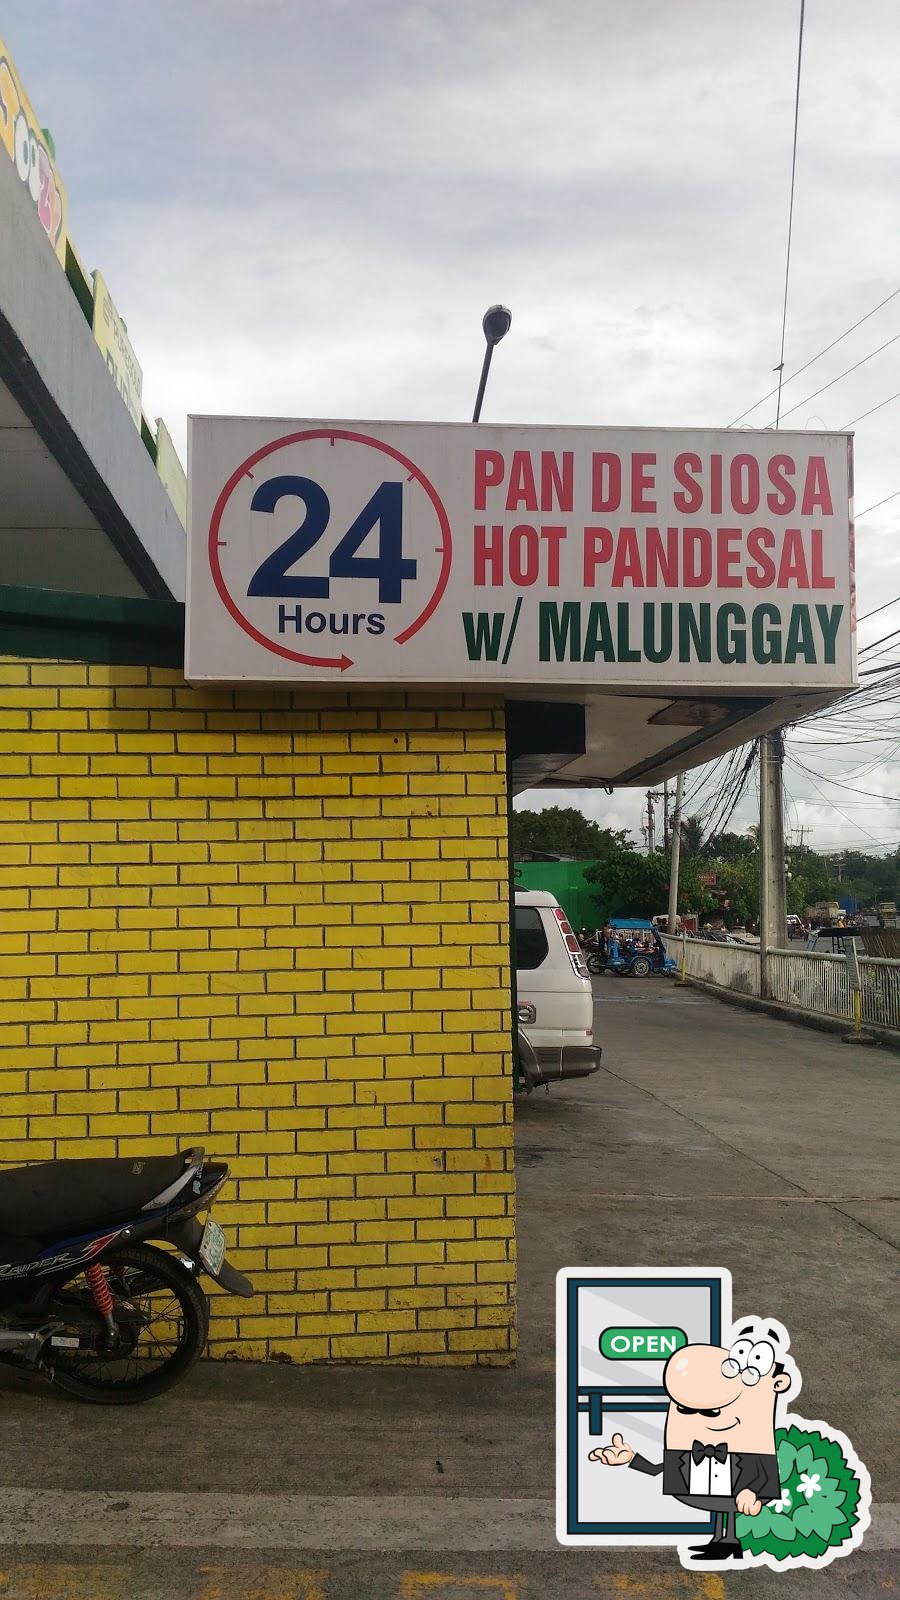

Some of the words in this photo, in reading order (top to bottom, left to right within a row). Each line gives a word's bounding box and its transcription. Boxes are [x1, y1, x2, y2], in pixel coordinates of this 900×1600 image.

[474, 449, 574, 512] PAN
[592, 452, 657, 513] DE
[673, 453, 834, 516] SIOSA
[247, 475, 417, 604] 24
[474, 525, 567, 587] HOT
[583, 527, 835, 589] PANDESAL
[279, 604, 386, 635] Hours
[539, 601, 844, 665] MALUNGGAY
